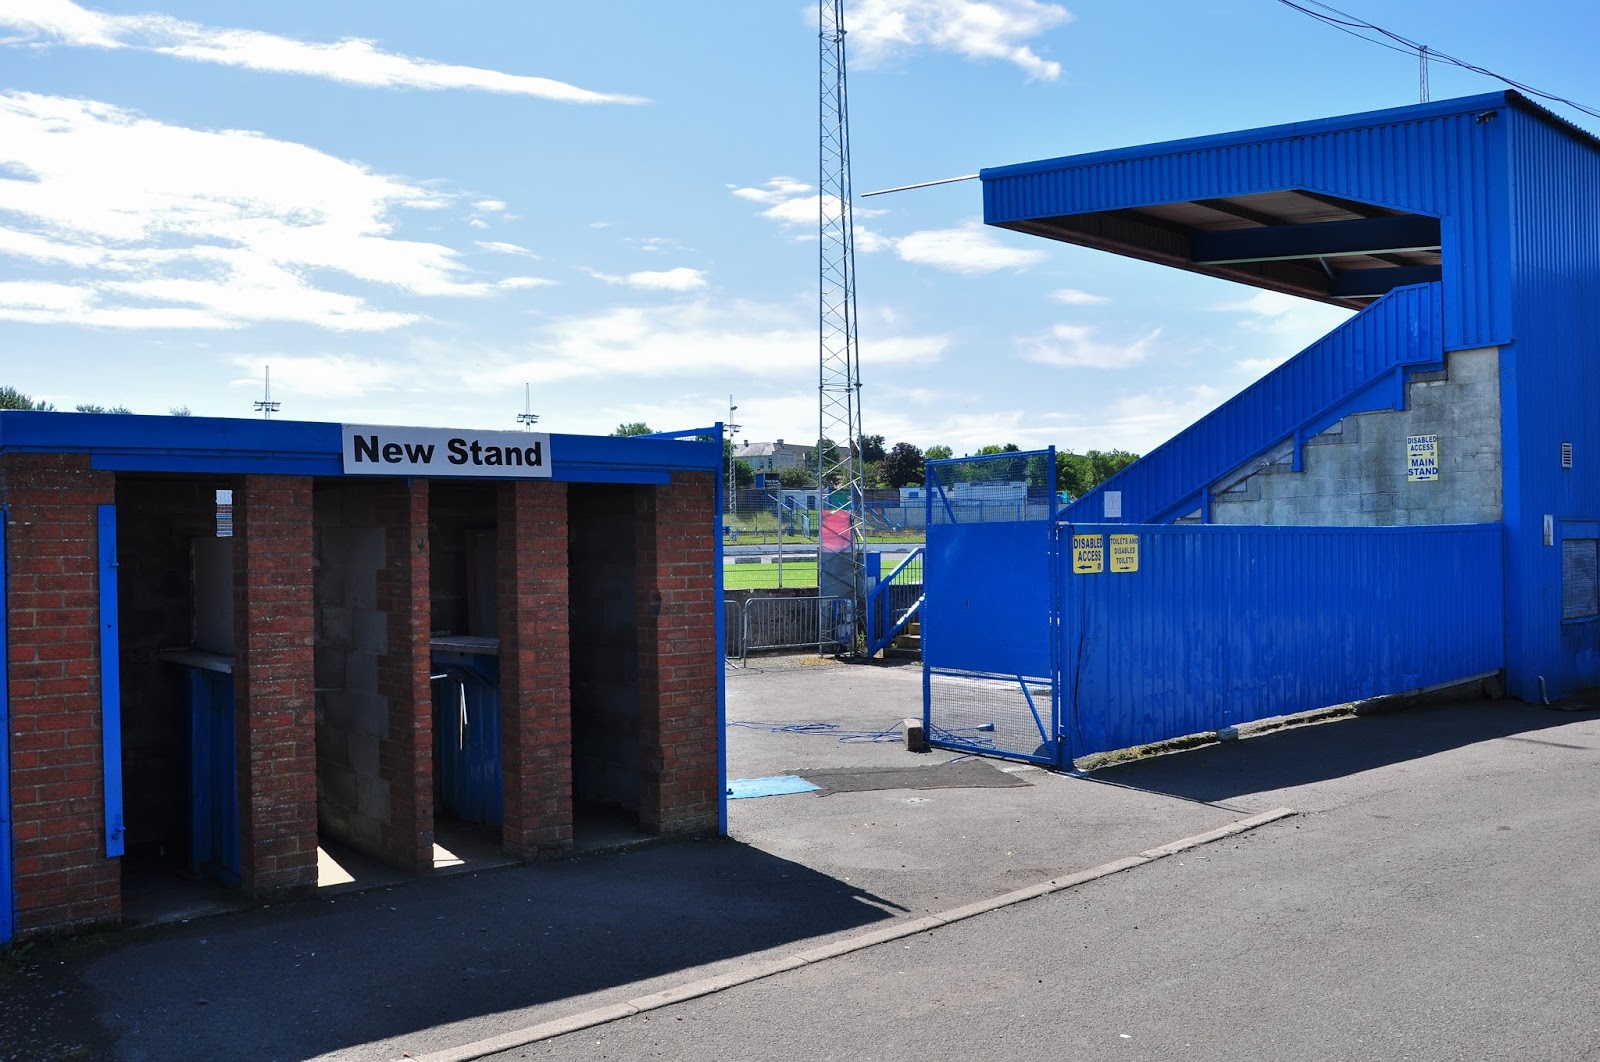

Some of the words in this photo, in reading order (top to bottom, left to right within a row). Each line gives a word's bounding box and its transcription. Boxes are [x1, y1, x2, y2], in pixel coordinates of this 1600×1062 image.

[1407, 436, 1437, 444] DISABLED
[353, 434, 435, 464] New
[447, 438, 542, 467] Stand
[1411, 458, 1435, 467] MAIN
[1408, 467, 1438, 476] STAND
[1073, 538, 1102, 549] DISABLED
[1129, 537, 1138, 545] AND
[1114, 547, 1135, 555] DISABLED
[1077, 550, 1102, 562] ACCESS
